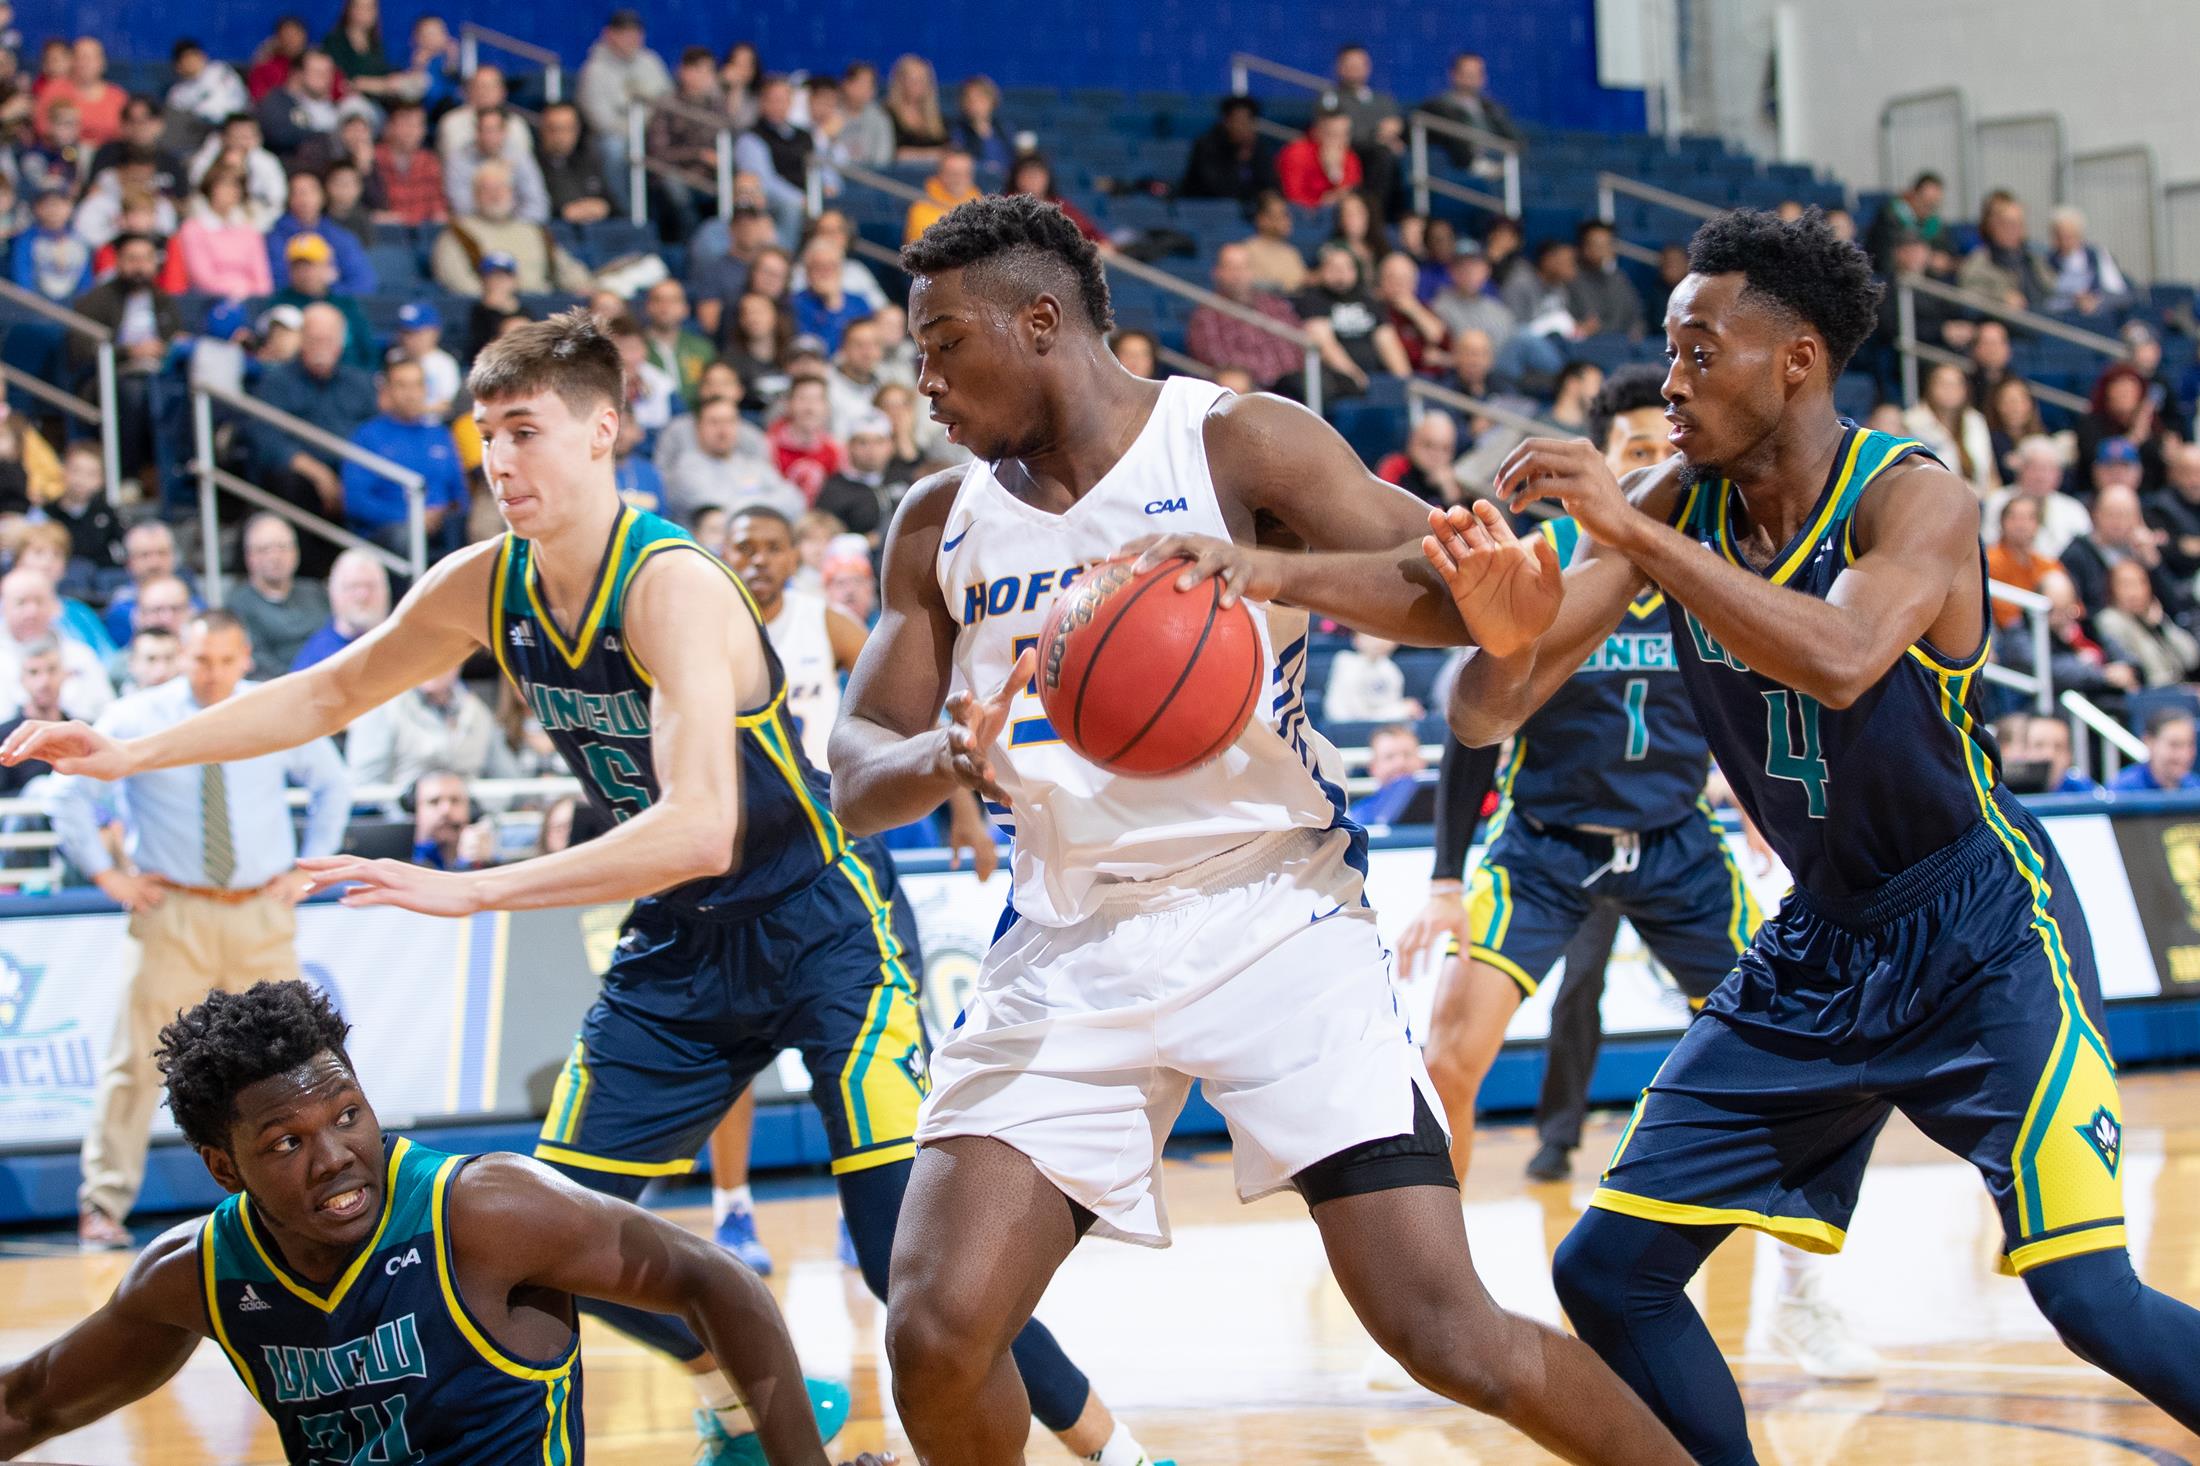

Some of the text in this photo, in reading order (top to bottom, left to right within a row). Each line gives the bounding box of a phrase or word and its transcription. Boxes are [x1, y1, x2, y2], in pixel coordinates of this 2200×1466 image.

[1144, 497, 1188, 515] CAA
[1577, 632, 1680, 672] NC
[1624, 677, 1649, 761] 1
[1760, 689, 1829, 818] 4
[260, 1312, 428, 1403] UNCW
